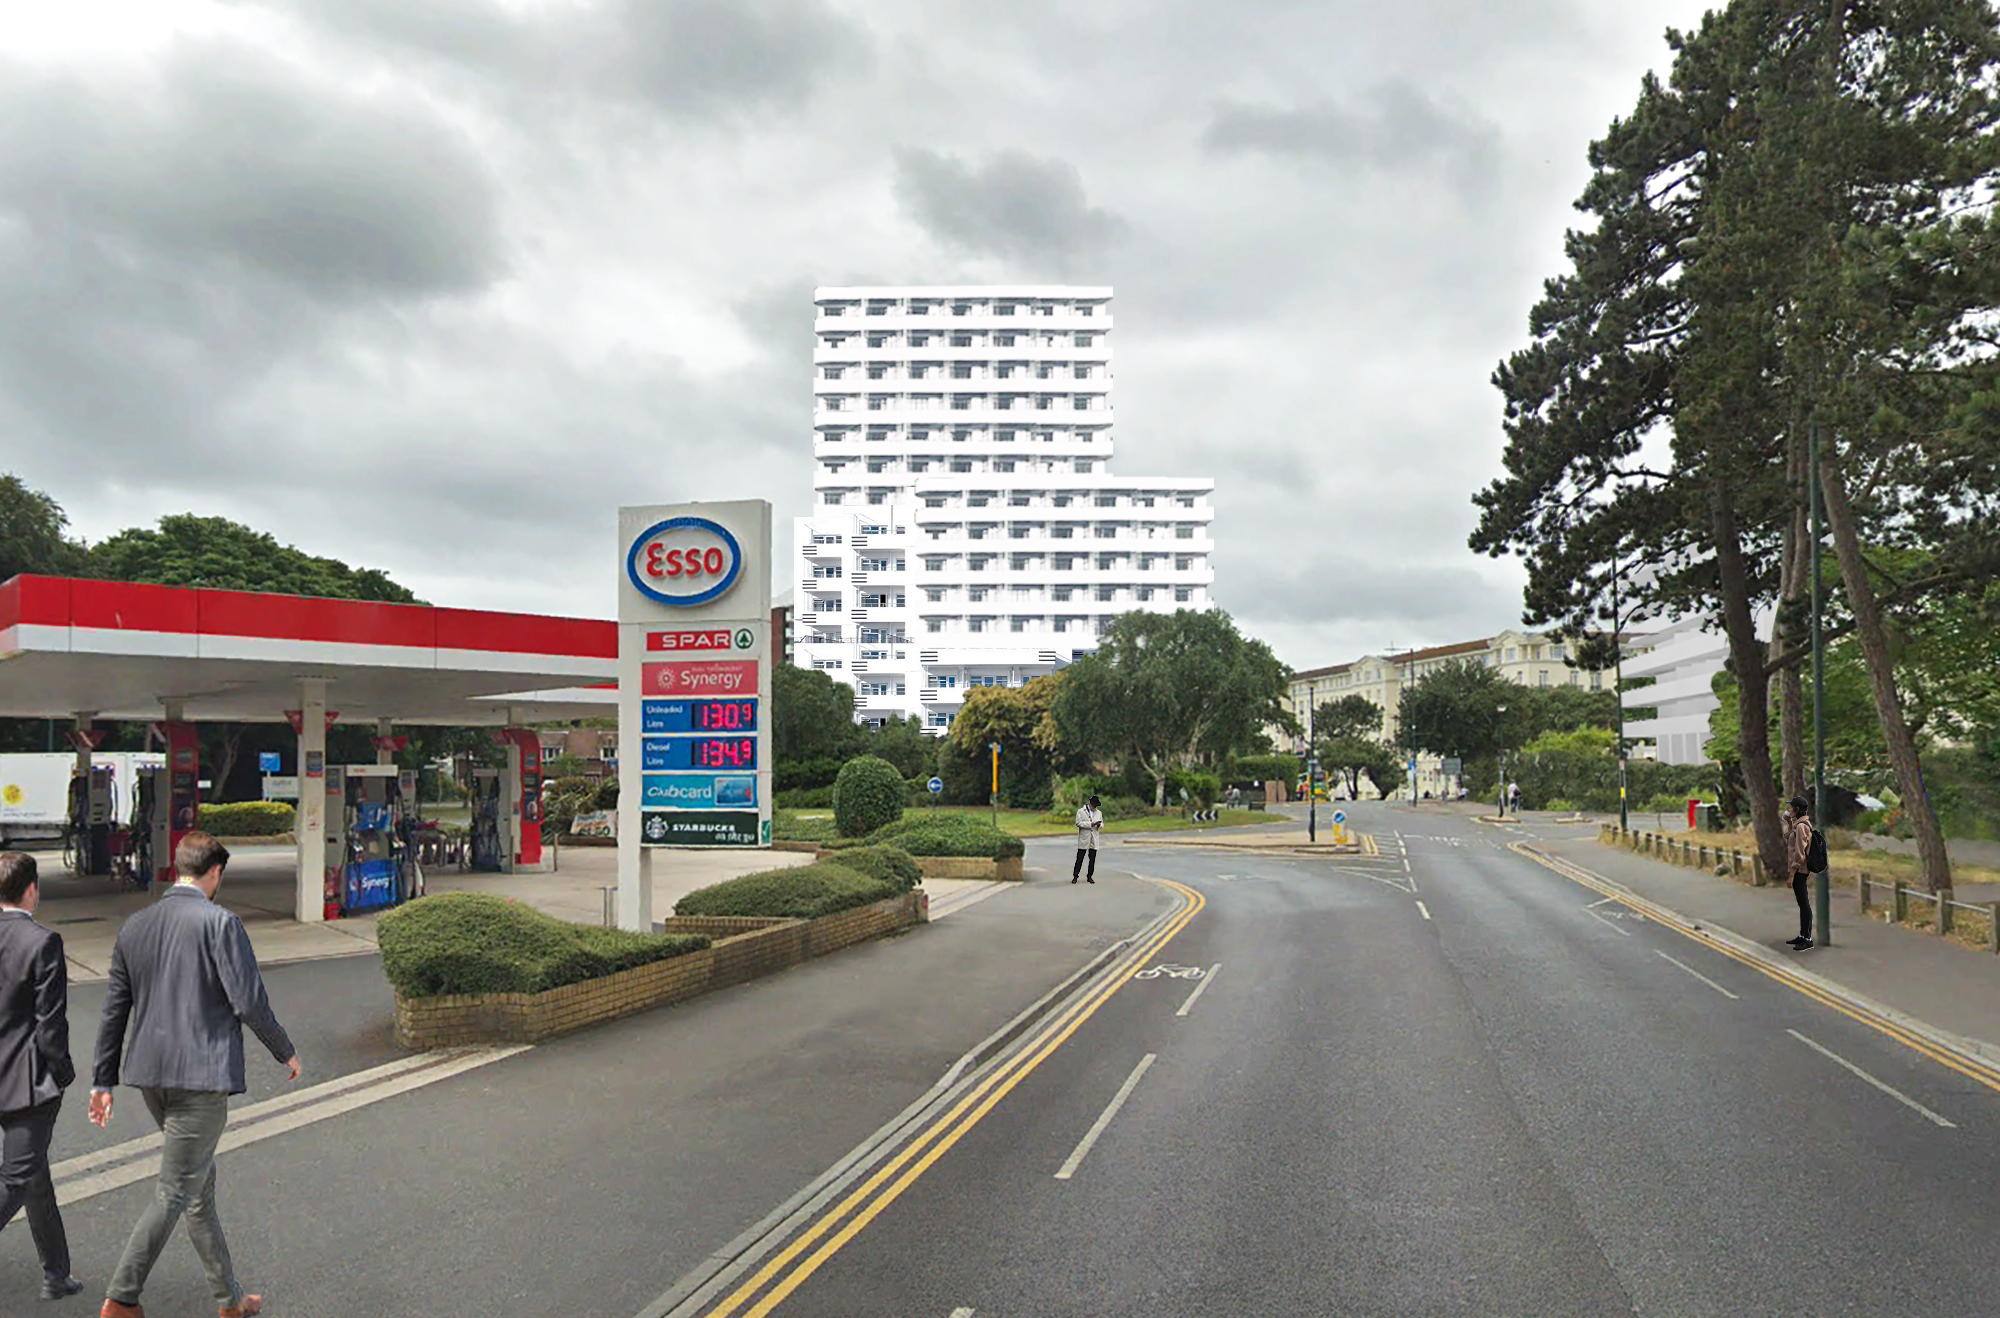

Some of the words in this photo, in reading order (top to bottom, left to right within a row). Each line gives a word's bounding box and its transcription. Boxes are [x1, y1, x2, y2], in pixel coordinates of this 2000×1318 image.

[646, 542, 723, 578] Esso
[662, 633, 730, 647] SPAR
[680, 671, 743, 688] Synergy
[646, 705, 683, 714] Unleaded
[646, 719, 664, 728] Litre
[646, 742, 670, 751] Diesel
[646, 757, 664, 766] Litre
[647, 784, 712, 799] Clubcard
[672, 823, 735, 832] STARBUCKS
